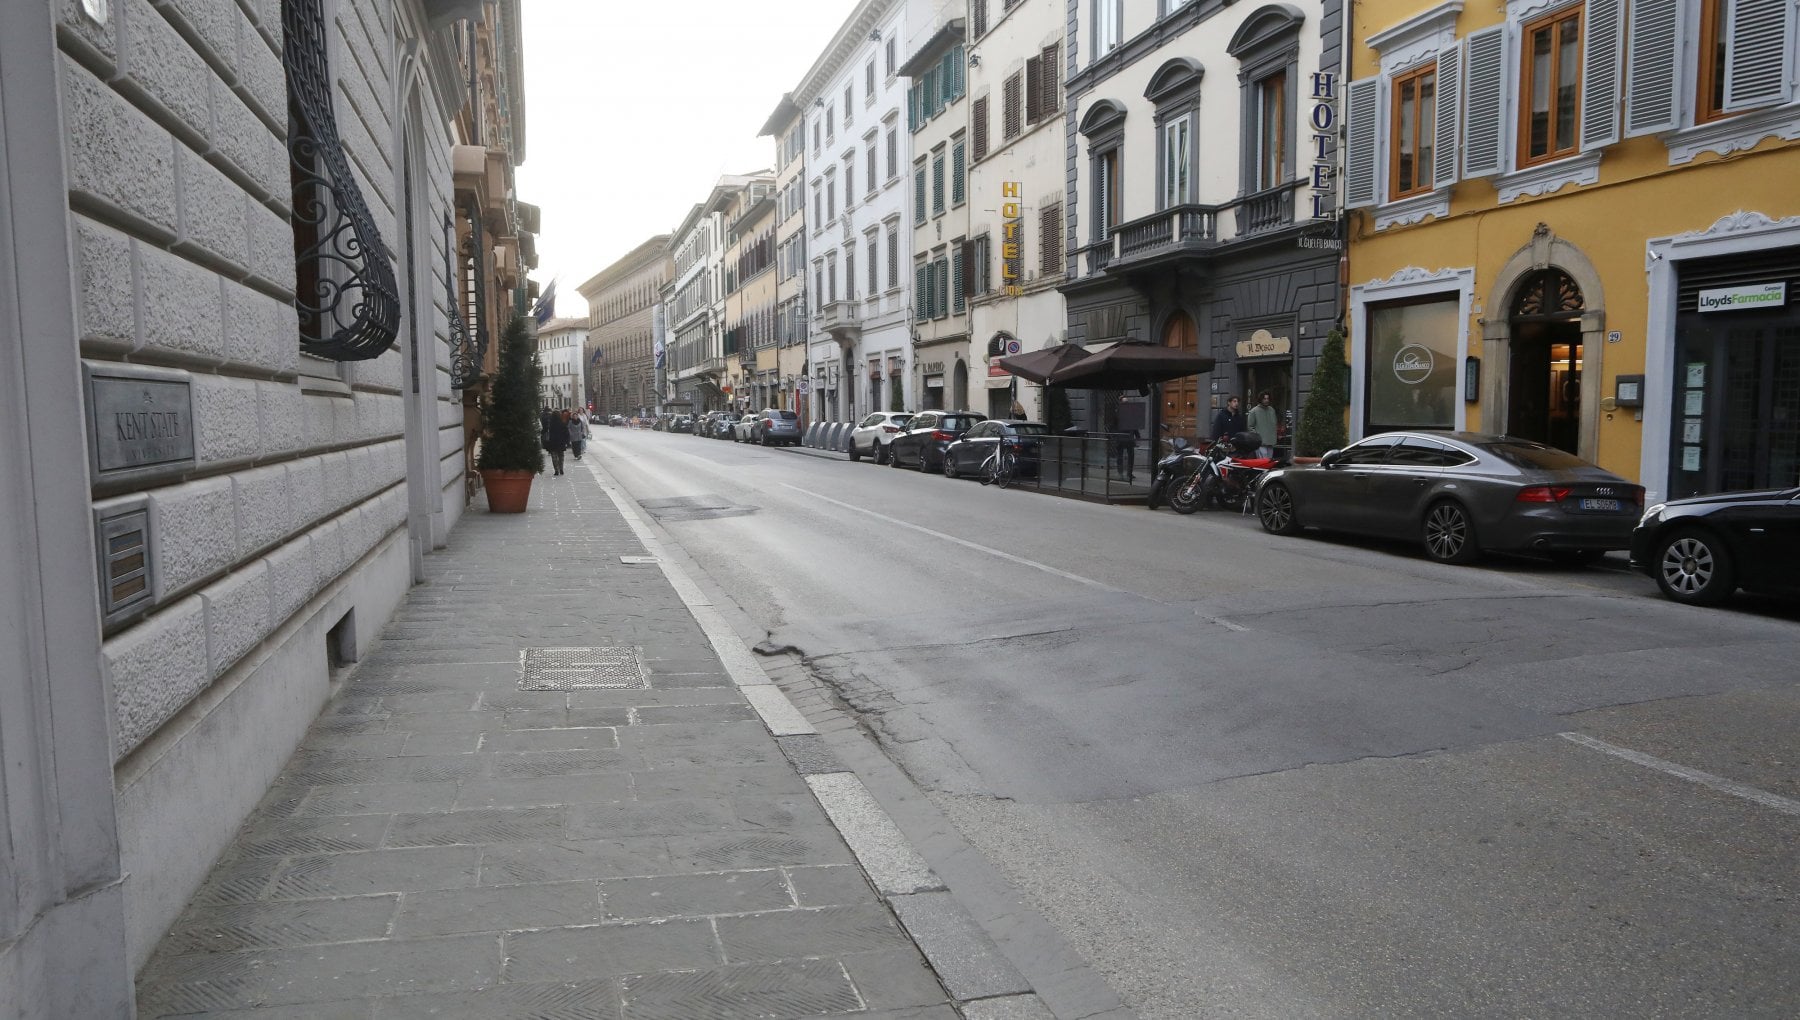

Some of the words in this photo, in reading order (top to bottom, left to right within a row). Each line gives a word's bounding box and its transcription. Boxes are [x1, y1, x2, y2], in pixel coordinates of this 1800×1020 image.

[1311, 72, 1333, 219] HOTEL
[1002, 181, 1018, 279] HOTEL
[1700, 291, 1782, 308] LloydsFarmacia
[115, 412, 148, 441] KENT
[150, 411, 180, 438] STATE
